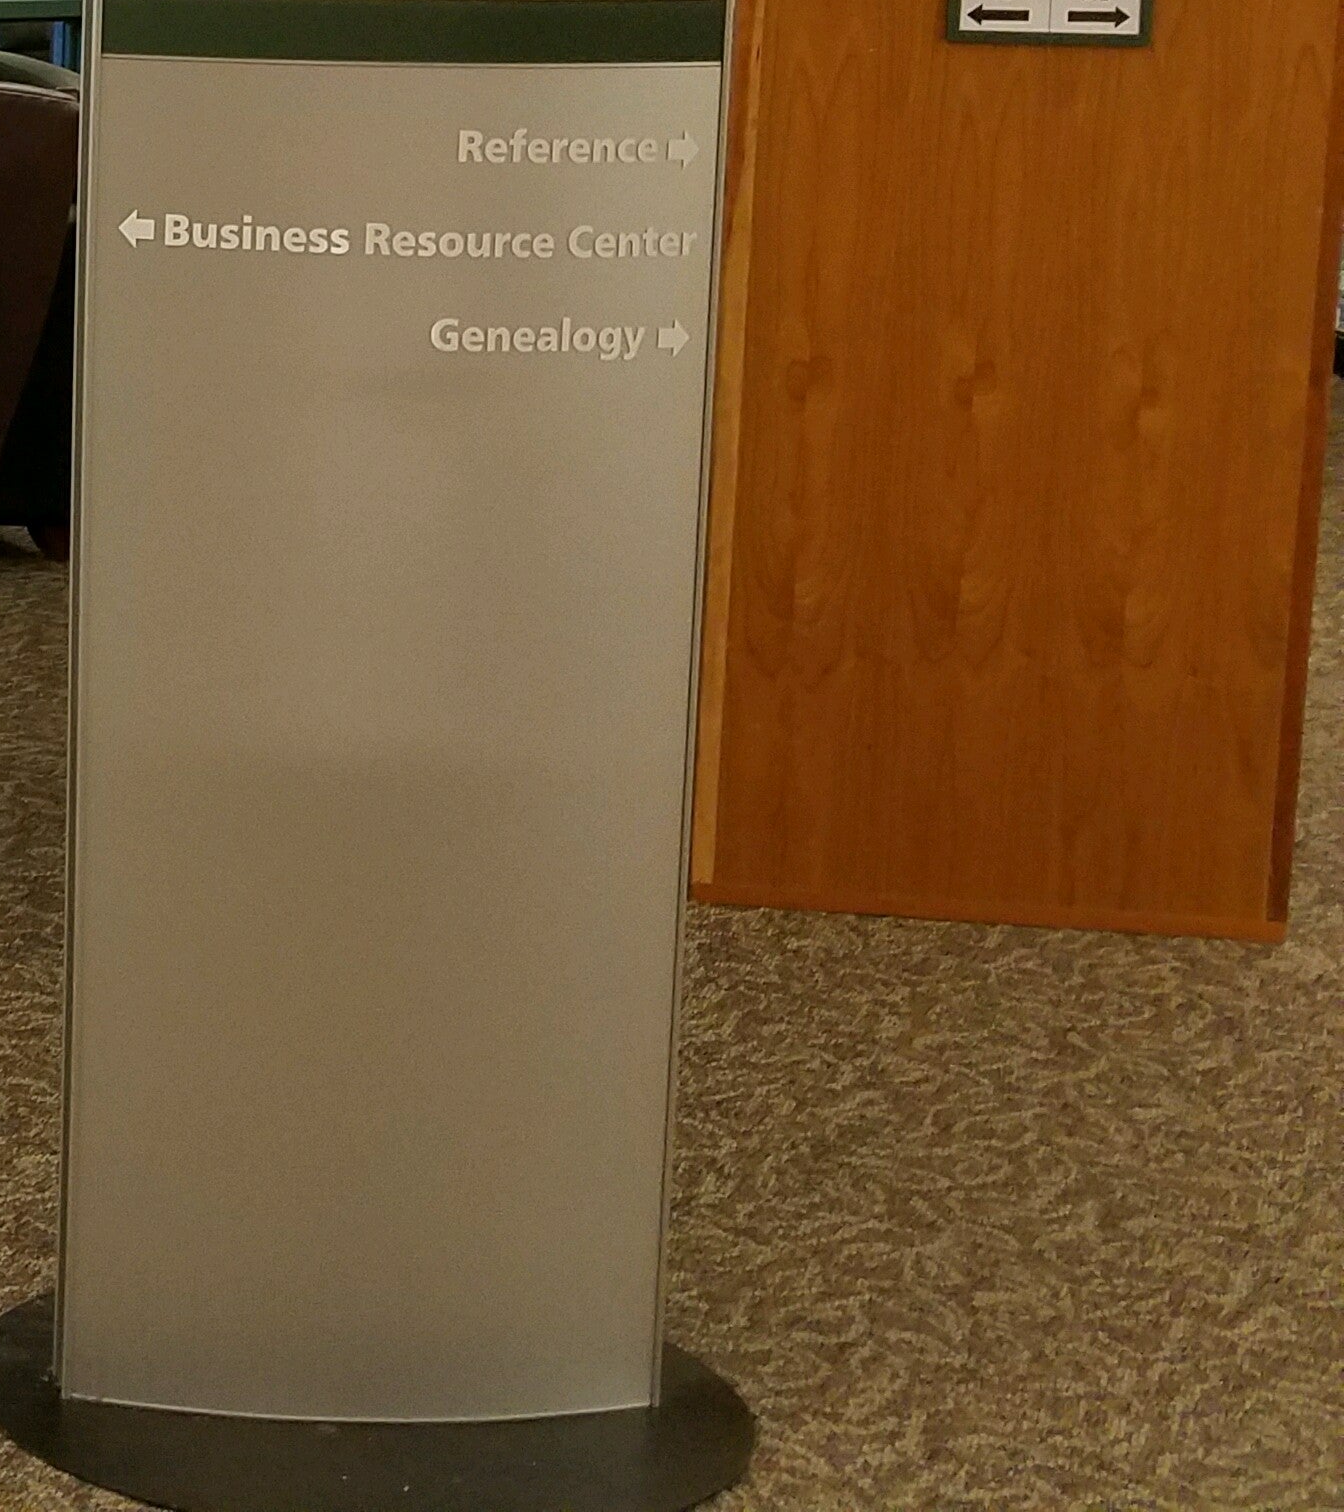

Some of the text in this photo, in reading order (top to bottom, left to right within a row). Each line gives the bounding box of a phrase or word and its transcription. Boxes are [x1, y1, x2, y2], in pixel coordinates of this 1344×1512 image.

[457, 128, 658, 165] Reference
[164, 213, 697, 259] Business Resource Center
[429, 316, 646, 361] Genealogy
